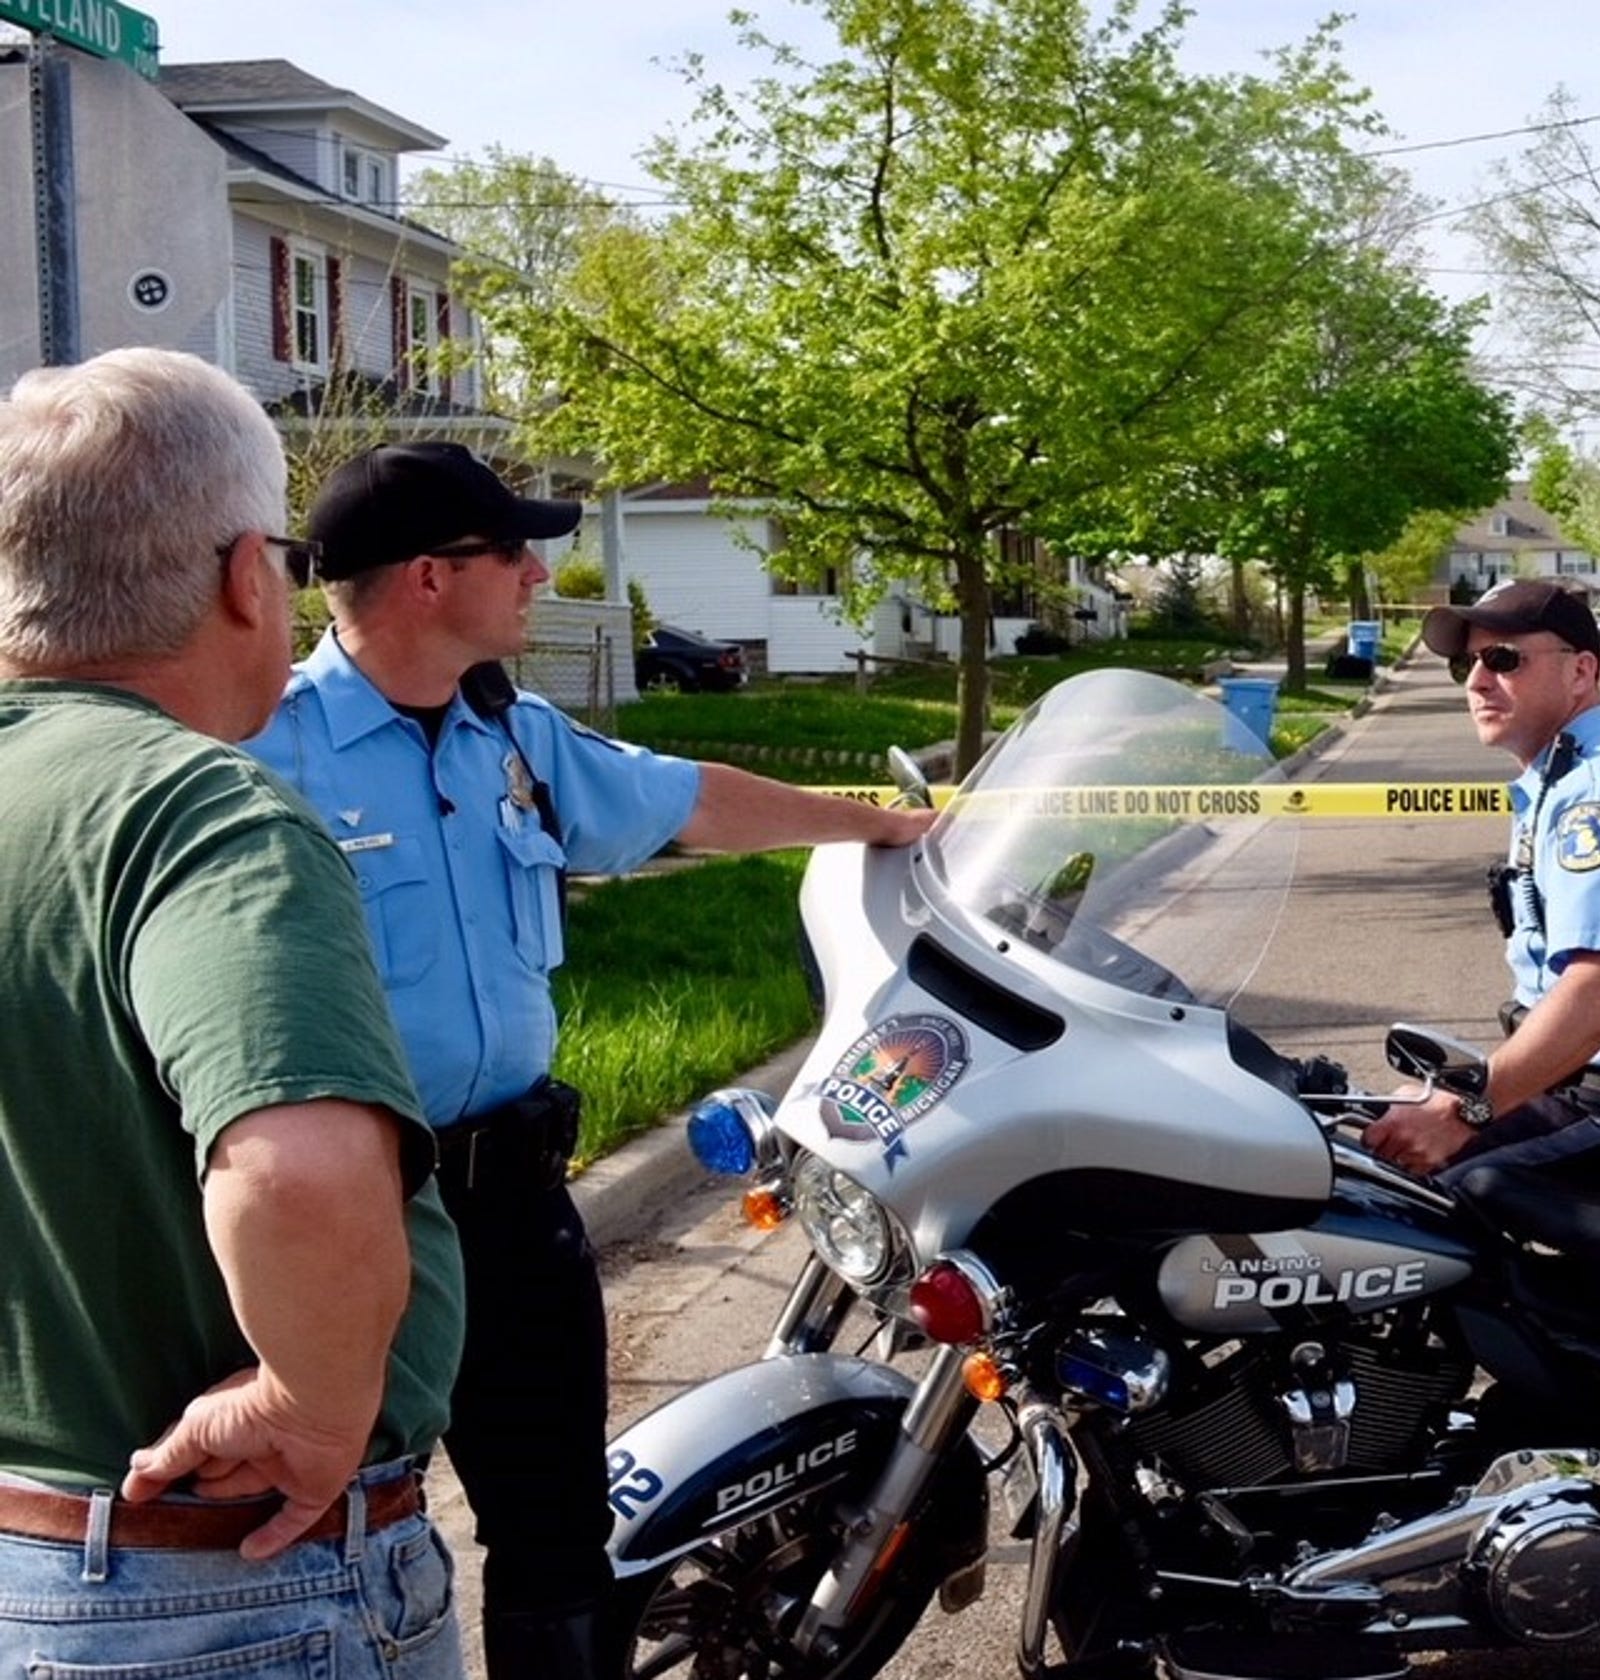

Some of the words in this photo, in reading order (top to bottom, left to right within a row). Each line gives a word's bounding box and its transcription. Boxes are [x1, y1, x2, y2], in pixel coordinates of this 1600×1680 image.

[1078, 791, 1118, 814] LINE
[1124, 791, 1149, 814] DO
[1157, 790, 1192, 814] NOT
[1199, 790, 1261, 814] CROSS
[1386, 788, 1453, 812] POLICE
[1460, 788, 1500, 812] LINE
[823, 1079, 900, 1138] POLICE
[901, 1060, 964, 1123] MICHIGAN
[1202, 1254, 1322, 1274] LANSING
[1213, 1261, 1426, 1310] POLICE
[716, 1428, 858, 1512] POLICE
